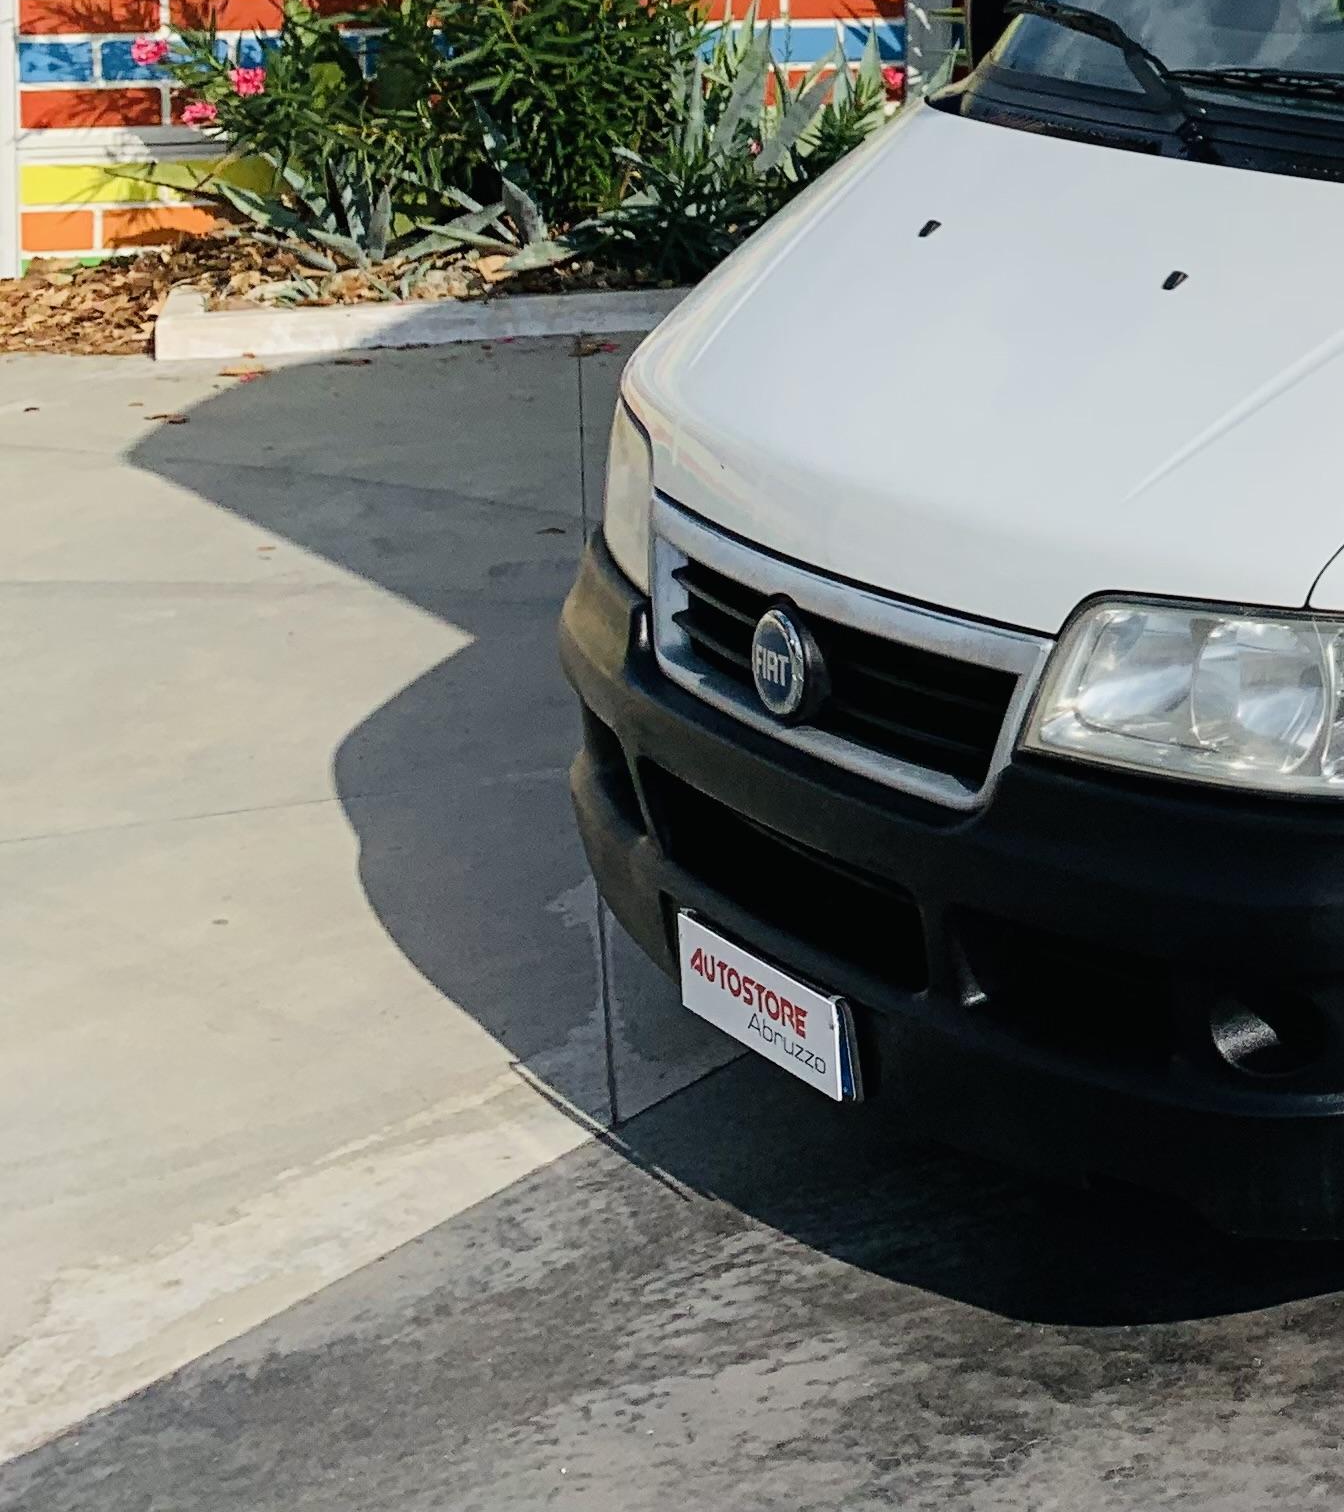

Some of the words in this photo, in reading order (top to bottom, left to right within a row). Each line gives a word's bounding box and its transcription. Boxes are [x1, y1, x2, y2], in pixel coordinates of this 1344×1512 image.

[755, 645, 790, 687] FIAT
[690, 947, 808, 1039] AUTOSTORE
[747, 1013, 827, 1075] Abruzzo
